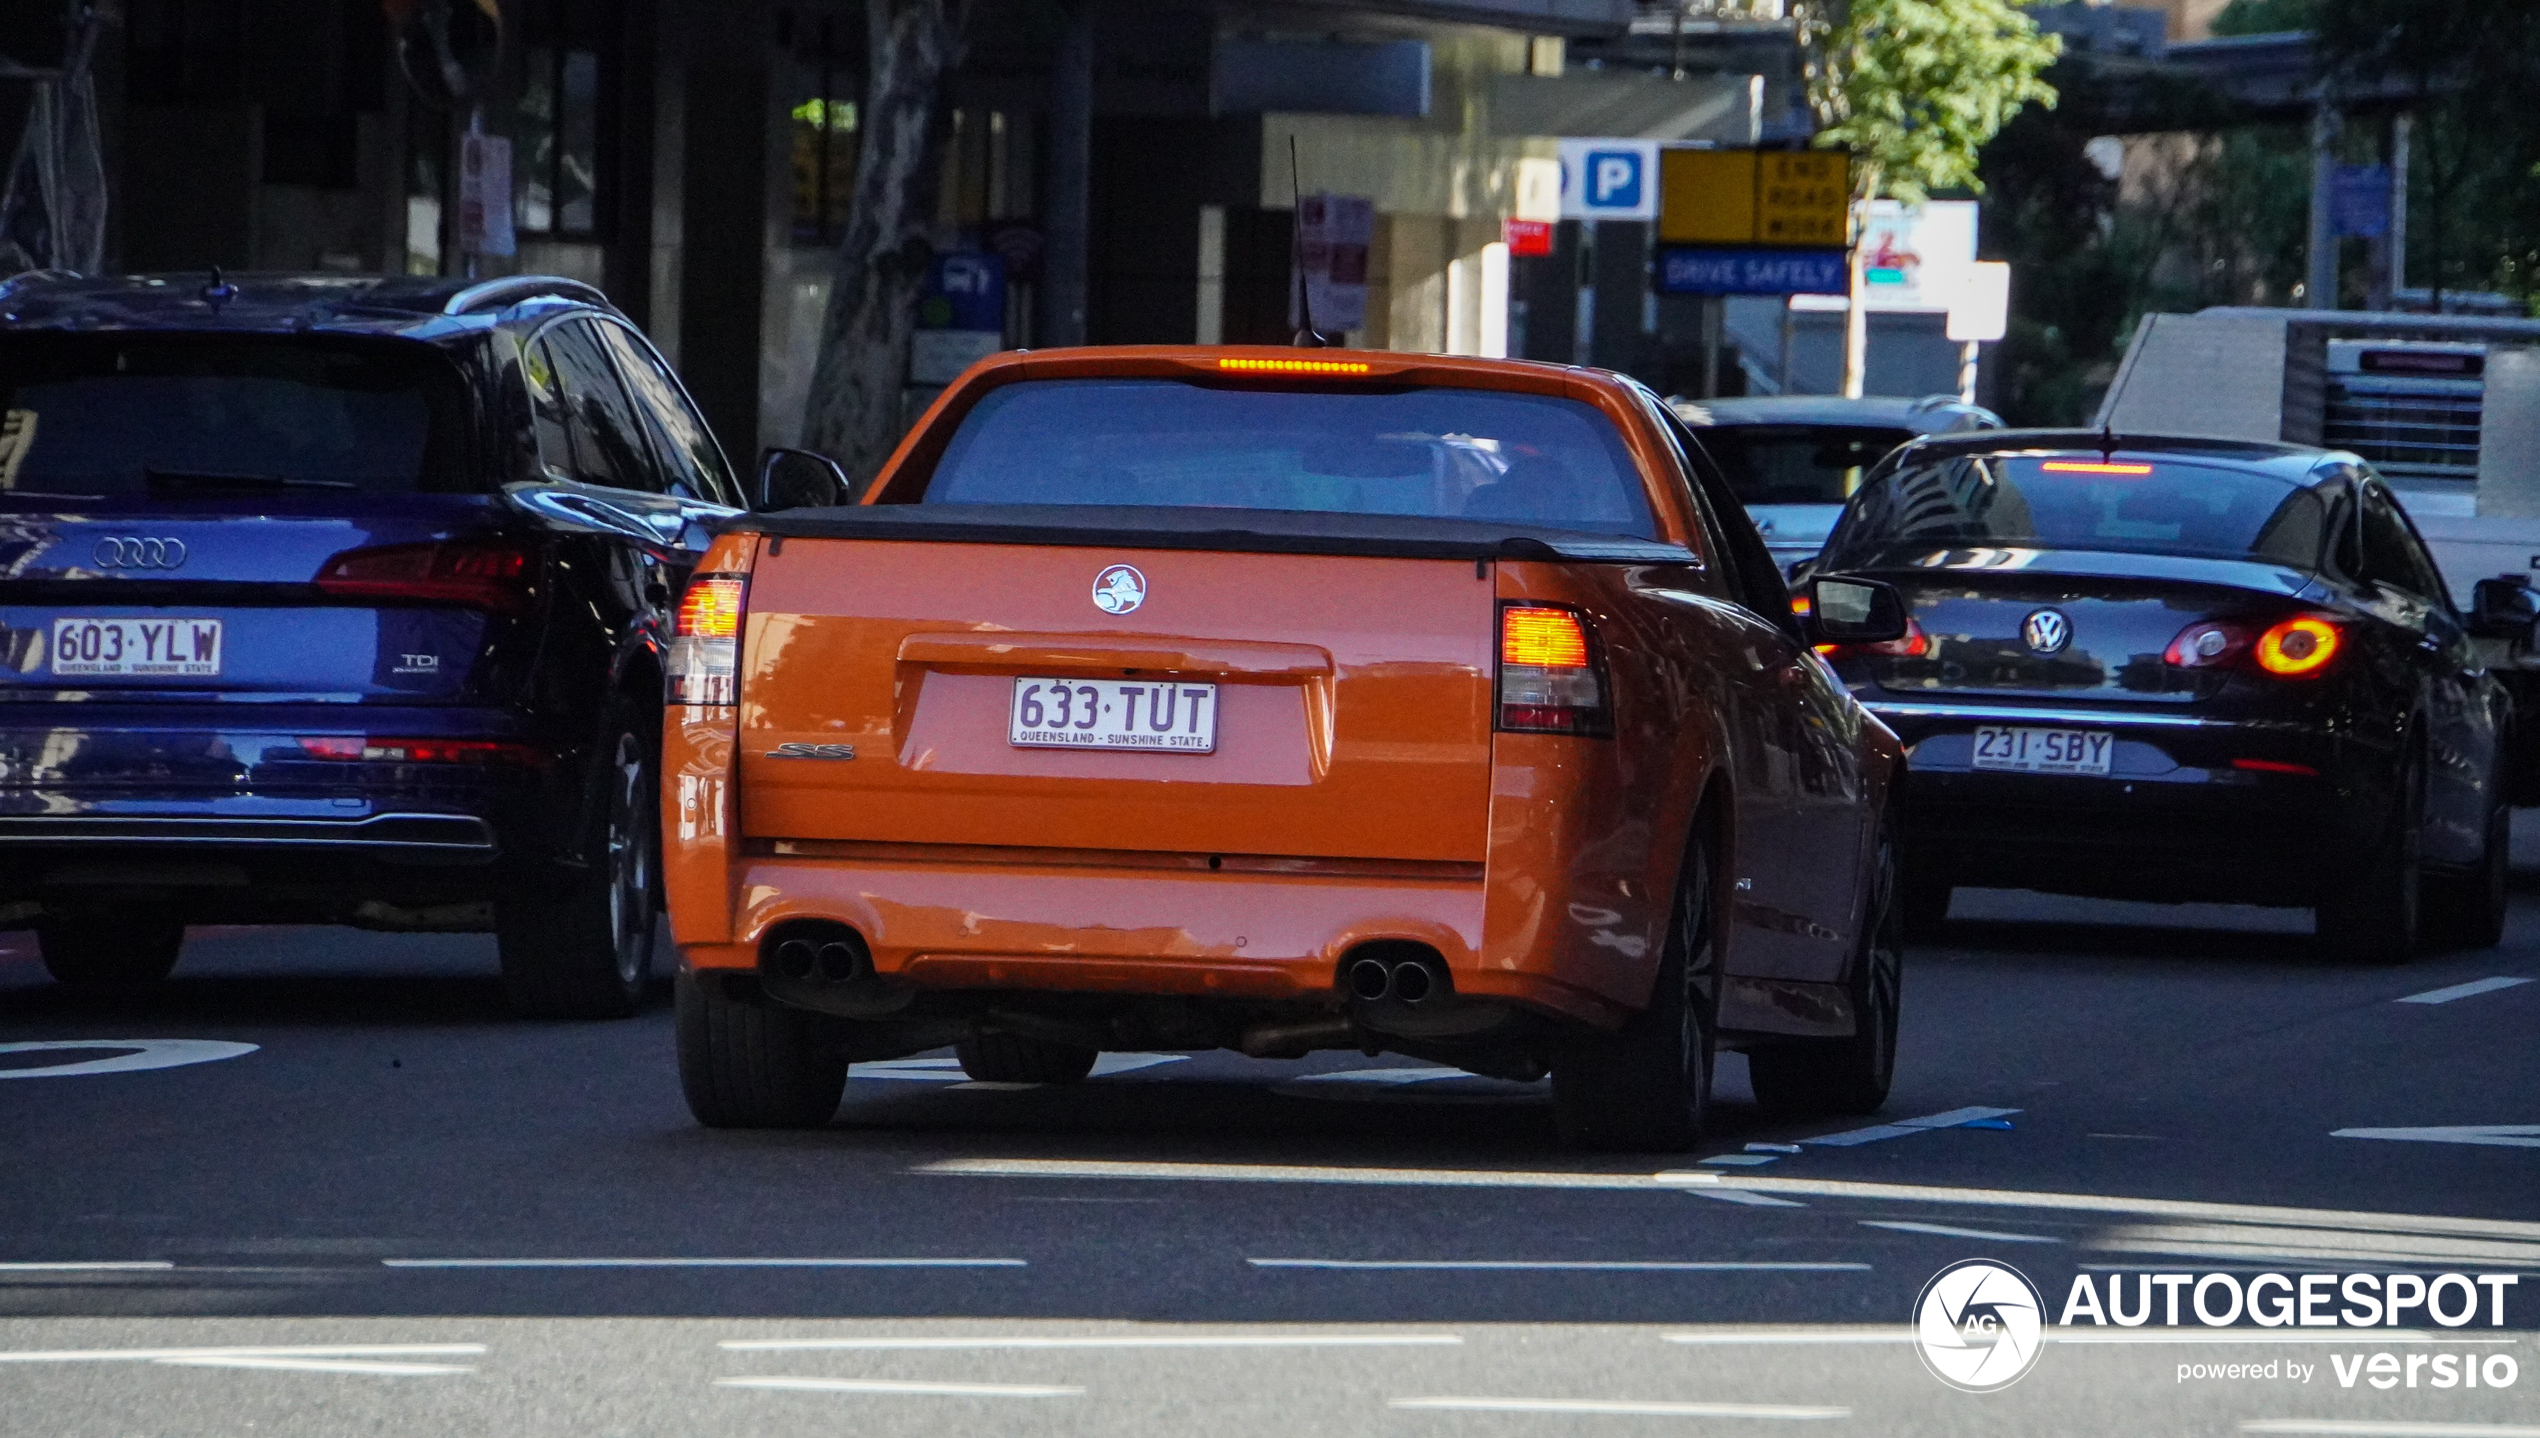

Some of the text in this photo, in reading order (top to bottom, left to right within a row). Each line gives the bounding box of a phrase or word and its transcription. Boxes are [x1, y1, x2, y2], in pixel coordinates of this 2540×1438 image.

[1596, 158, 1632, 201] P
[1745, 259, 1837, 287] SAFELY
[400, 653, 439, 666] TDI
[1020, 731, 1095, 744] QUEENSLAND
[1107, 734, 1164, 746] SUNSHINE
[1169, 735, 1204, 748] STATE
